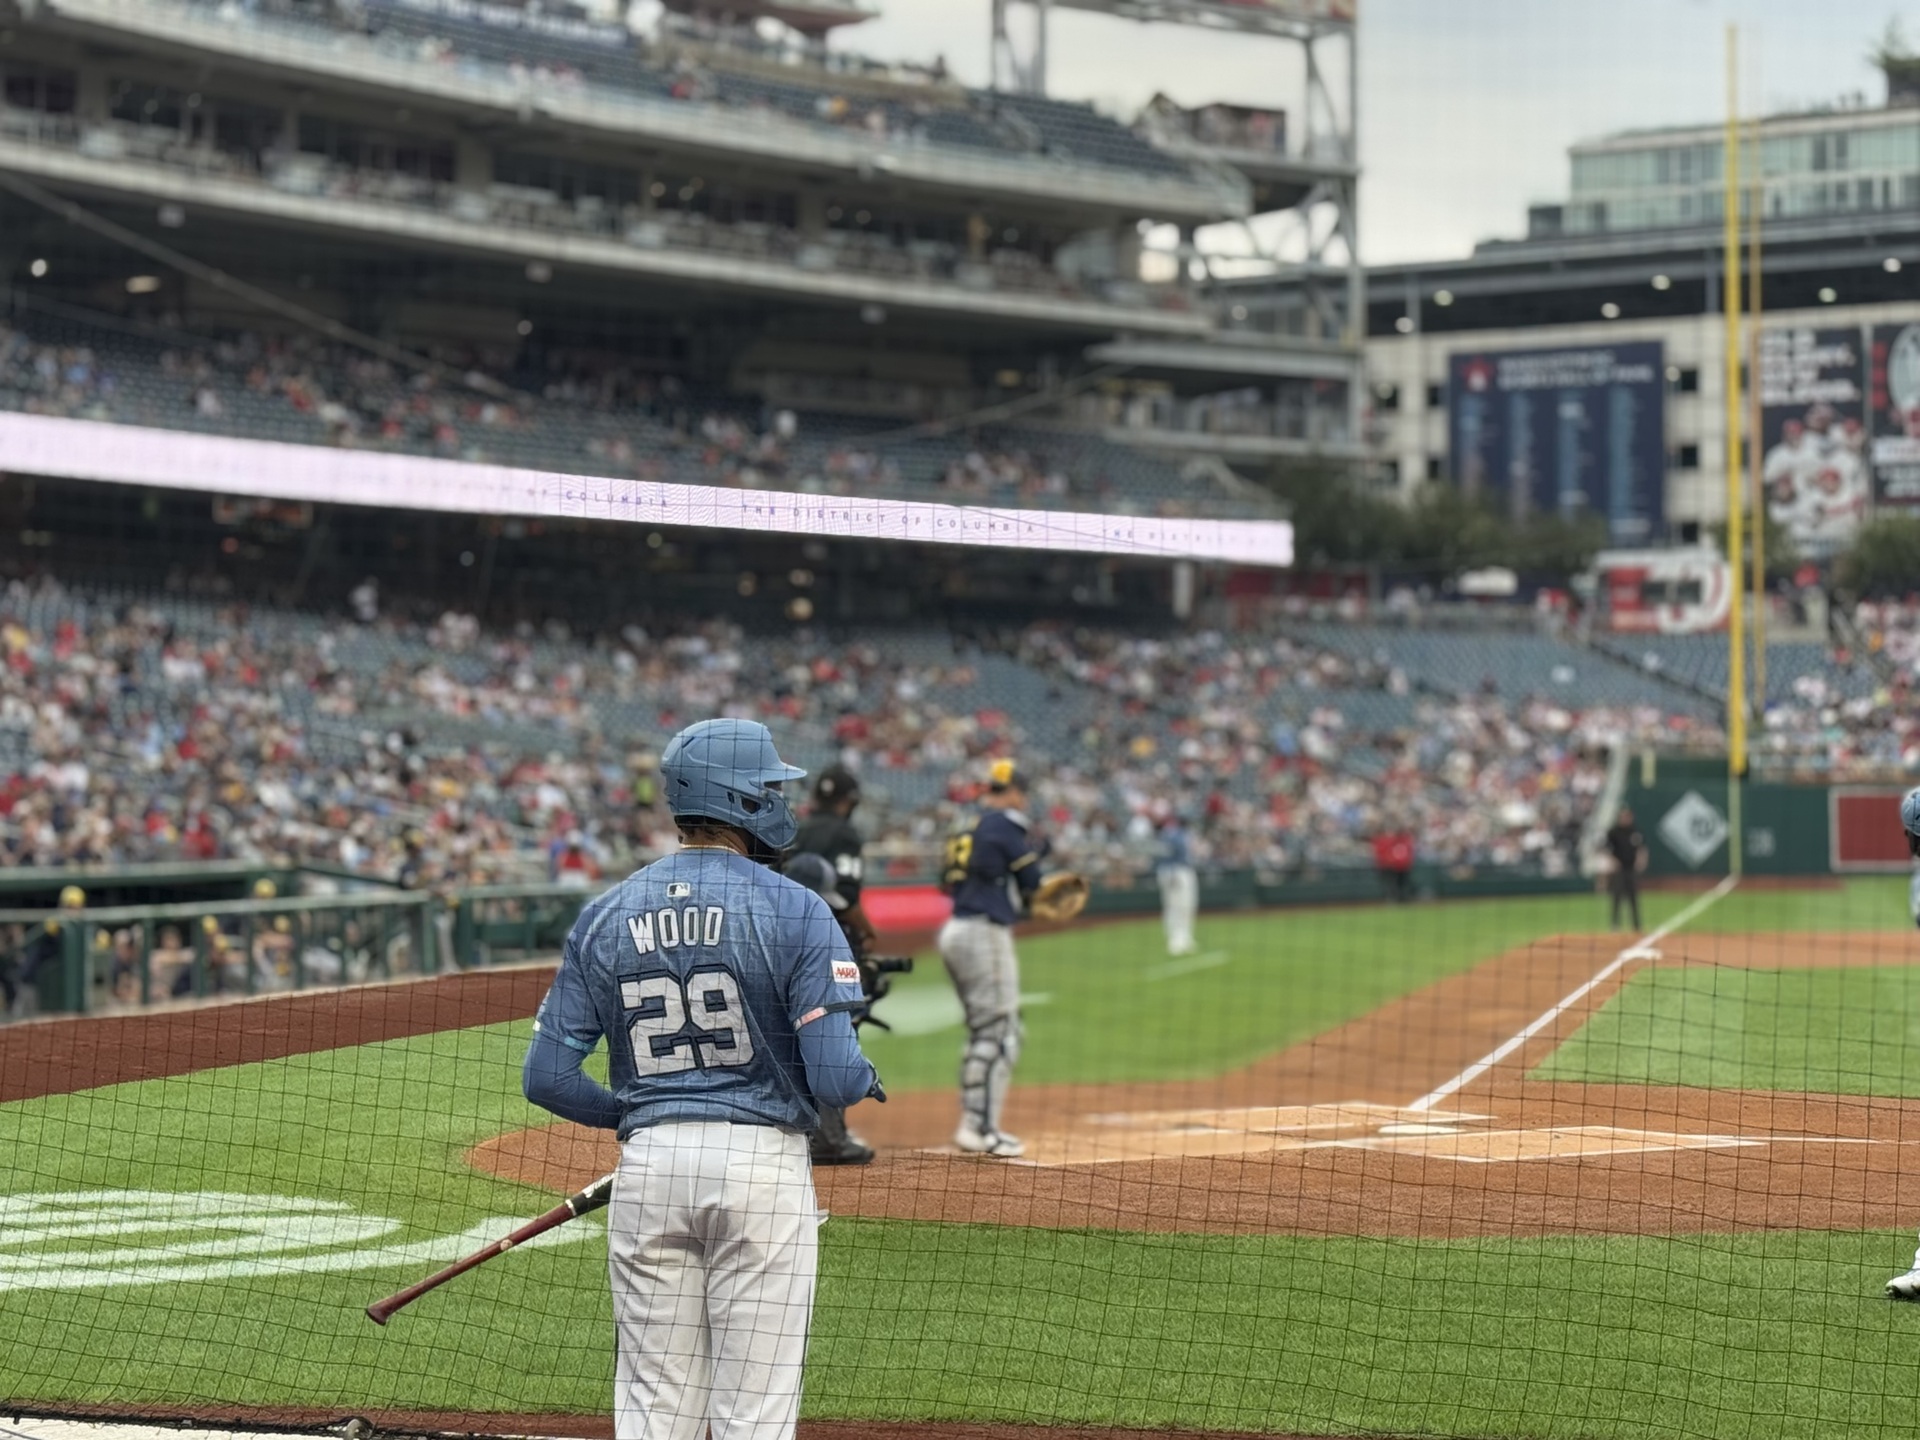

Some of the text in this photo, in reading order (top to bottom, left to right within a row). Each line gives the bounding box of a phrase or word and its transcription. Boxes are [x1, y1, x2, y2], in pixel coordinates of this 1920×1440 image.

[566, 490, 667, 507] COLUMBIA
[742, 504, 1033, 533] THE DISTRICT OF COLUMBIA
[627, 905, 724, 955] WOOD
[617, 963, 756, 1078] 29
